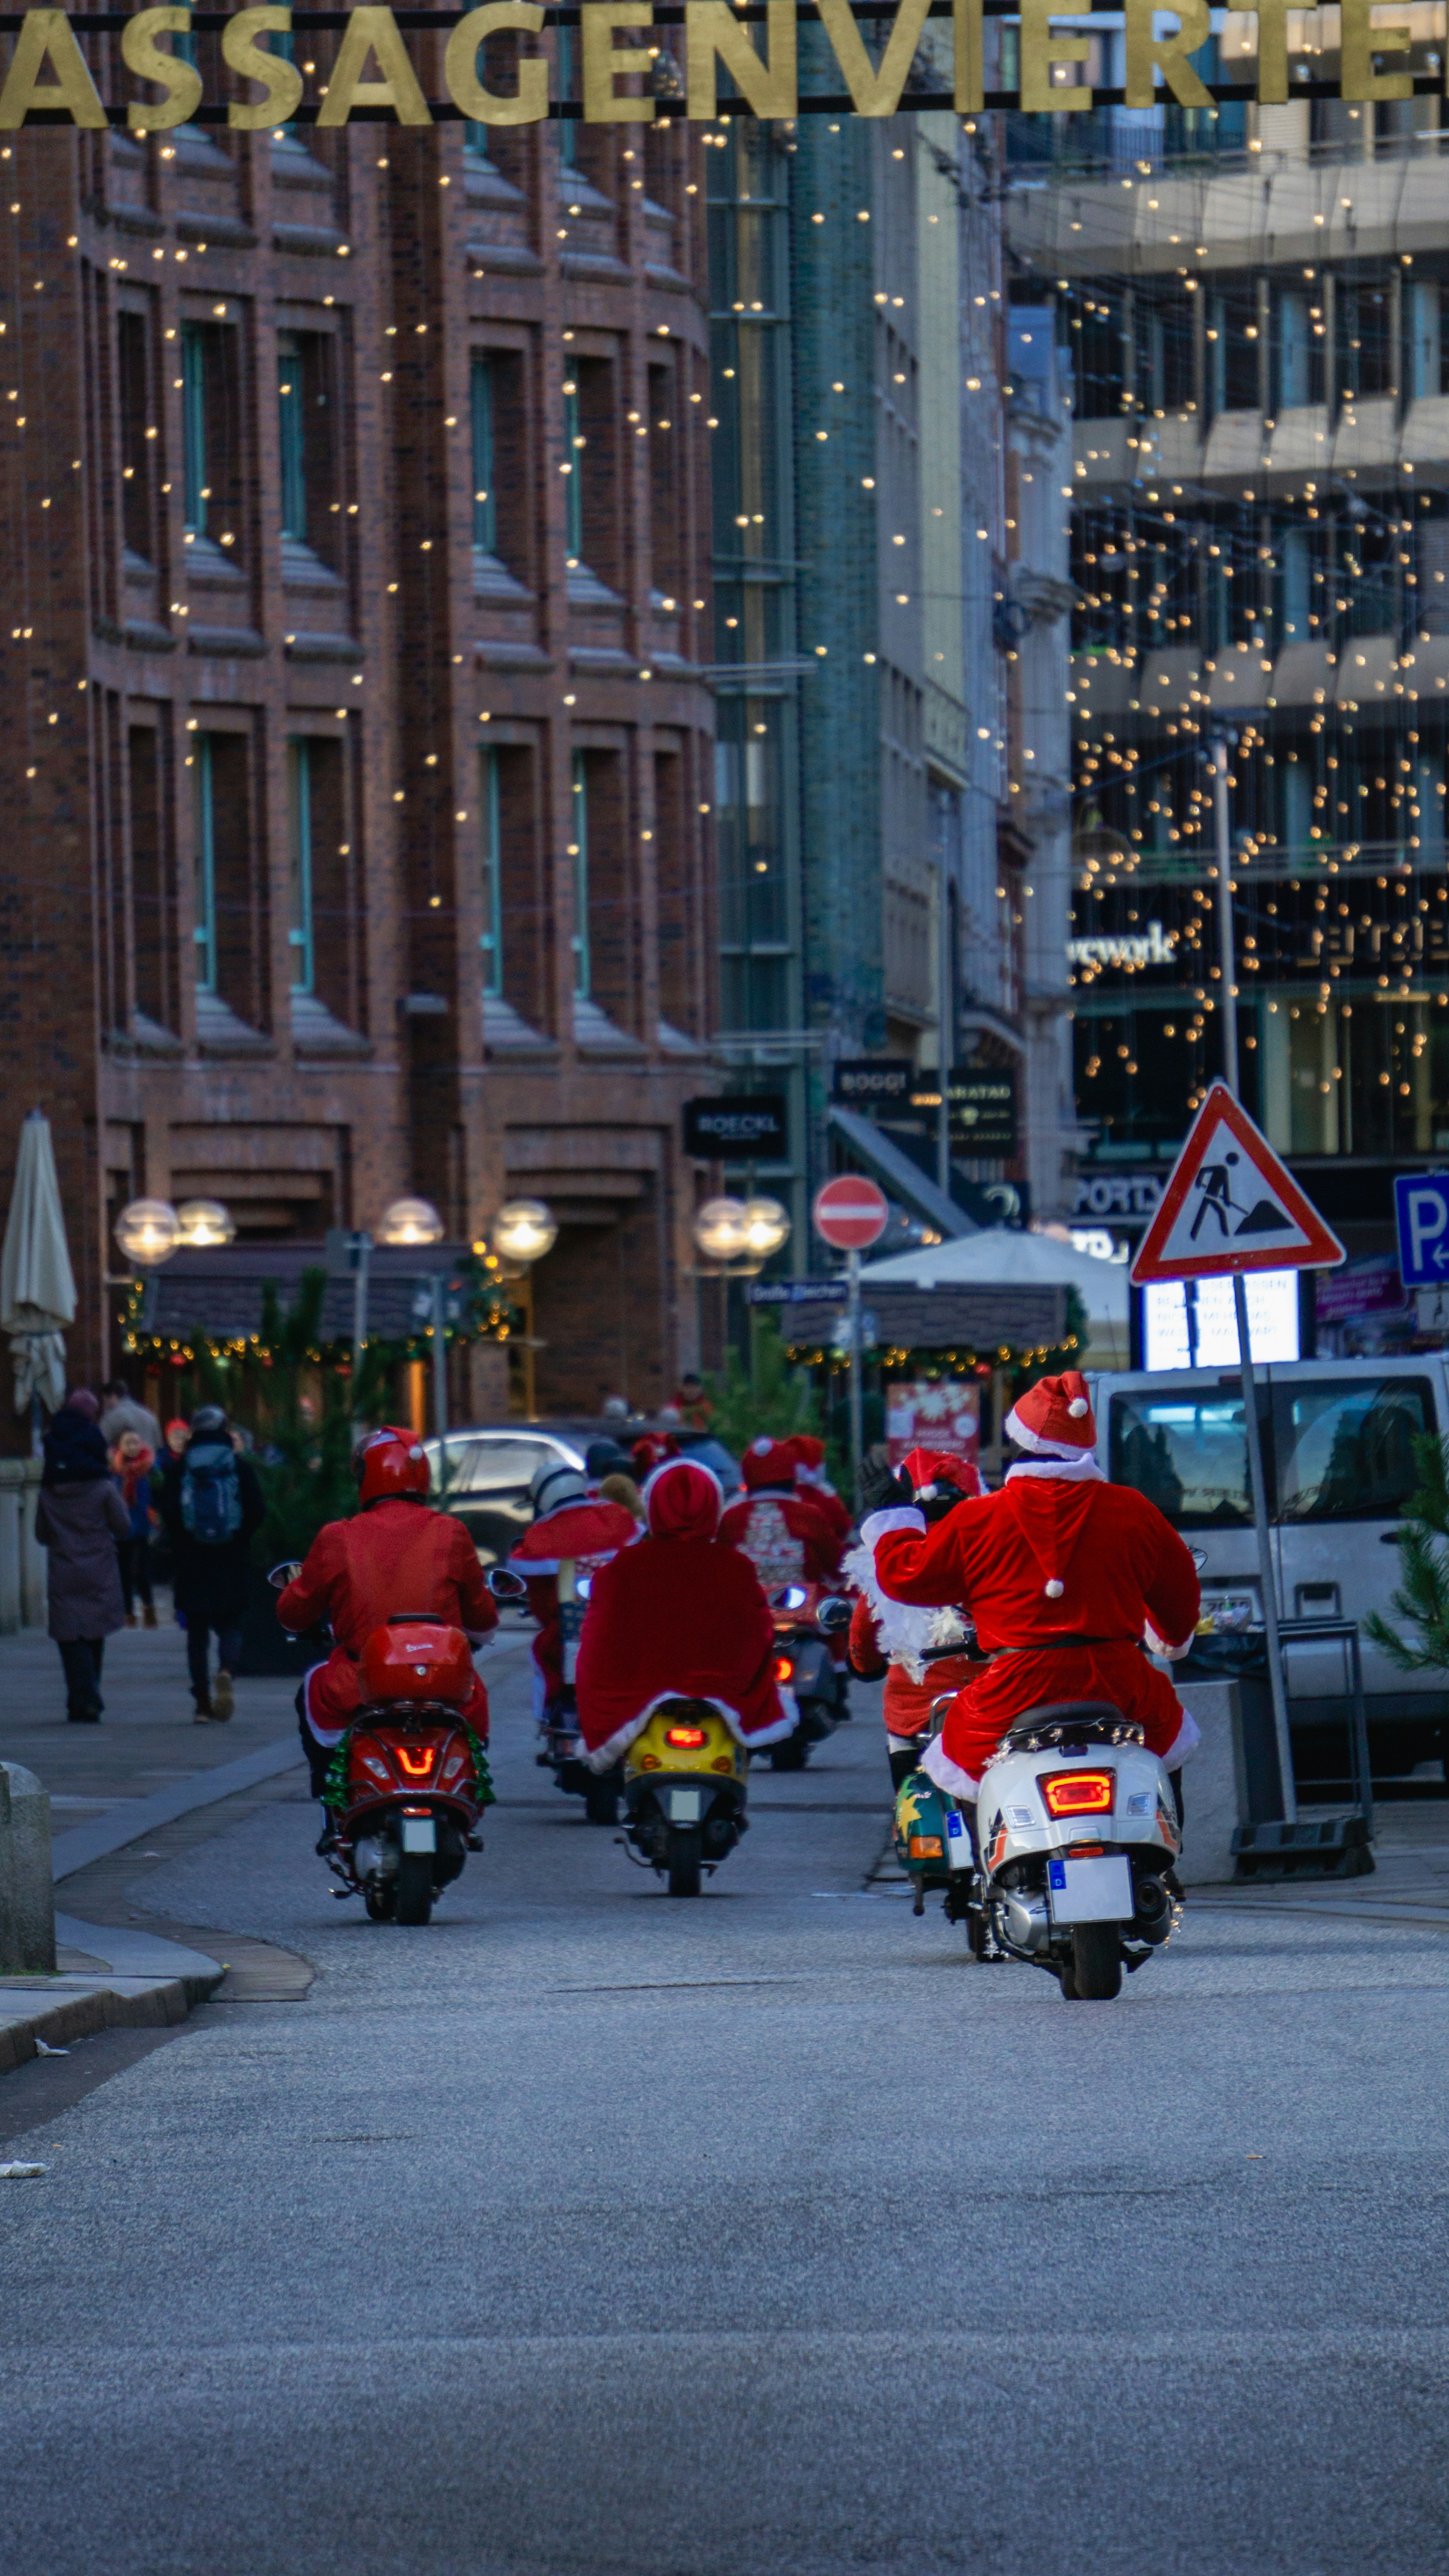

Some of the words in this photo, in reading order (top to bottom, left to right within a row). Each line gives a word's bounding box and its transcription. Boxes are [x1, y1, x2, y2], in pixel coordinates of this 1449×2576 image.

[0, 1, 1449, 130] ASSAGENVIERTE
[698, 1115, 780, 1132] ROECKL
[1408, 1189, 1448, 1271] P
